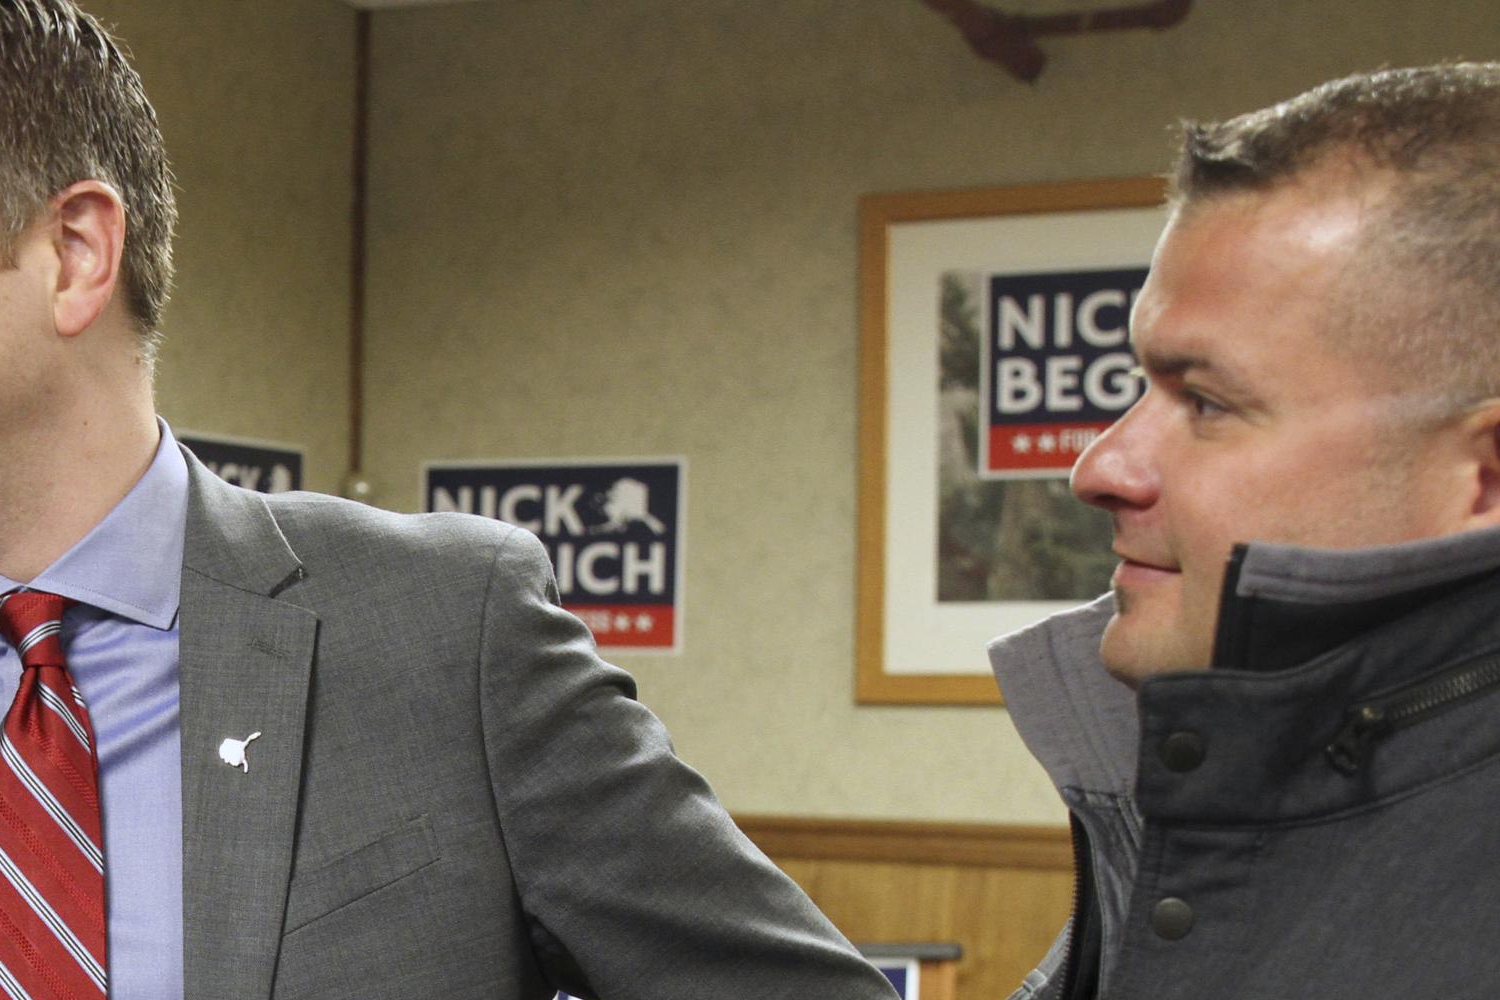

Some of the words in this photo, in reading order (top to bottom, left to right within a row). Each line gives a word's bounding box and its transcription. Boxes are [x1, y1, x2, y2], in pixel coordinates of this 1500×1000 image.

[998, 289, 1140, 350] NIC
[996, 352, 1139, 414] BEG
[555, 542, 666, 595] ICH
